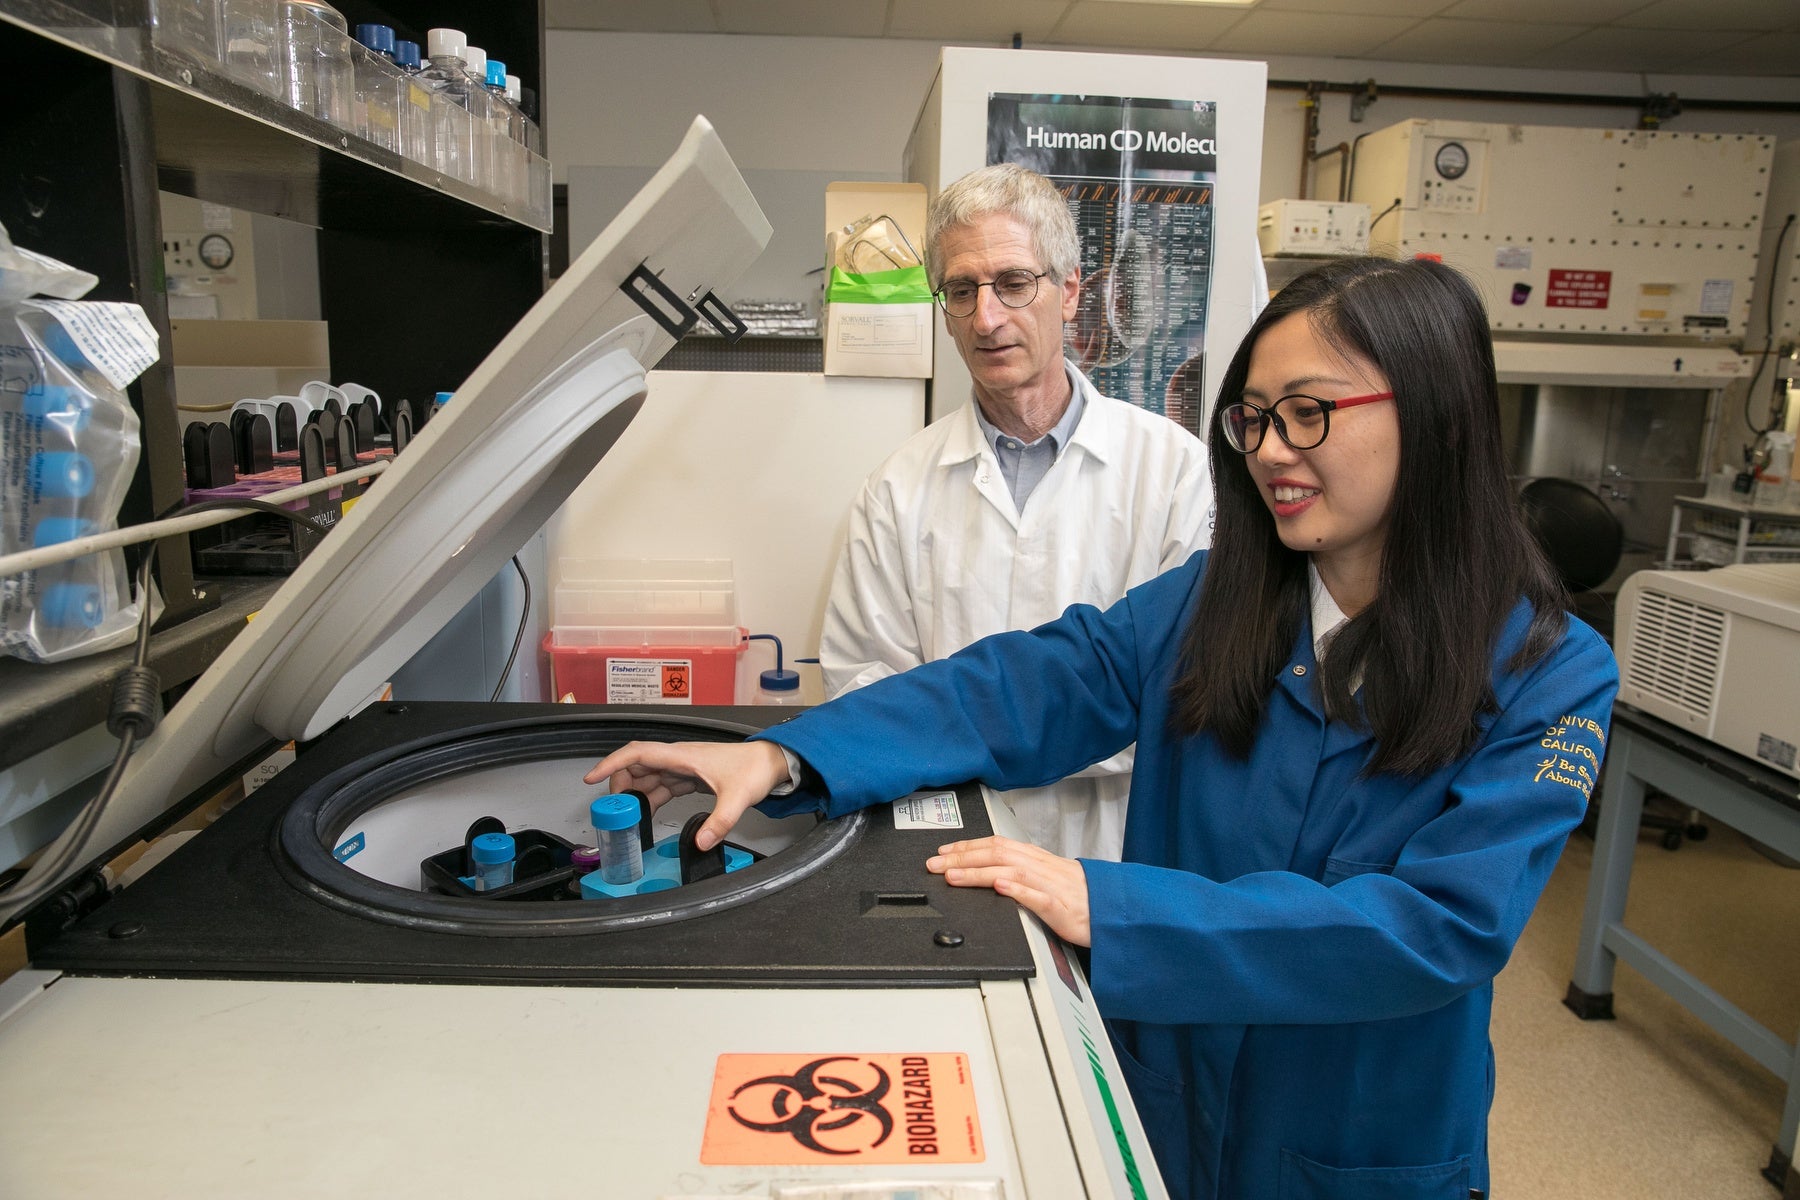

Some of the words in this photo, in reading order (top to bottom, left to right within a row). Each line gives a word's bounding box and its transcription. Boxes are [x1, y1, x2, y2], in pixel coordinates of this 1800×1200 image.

[1026, 126, 1106, 150] Human
[1110, 129, 1143, 151] CD
[1146, 131, 1216, 154] Molecu
[1546, 727, 1567, 737] OF
[1558, 758, 1576, 772] Be
[1545, 771, 1582, 788] About
[901, 1057, 938, 1155] BIOHAZARD
